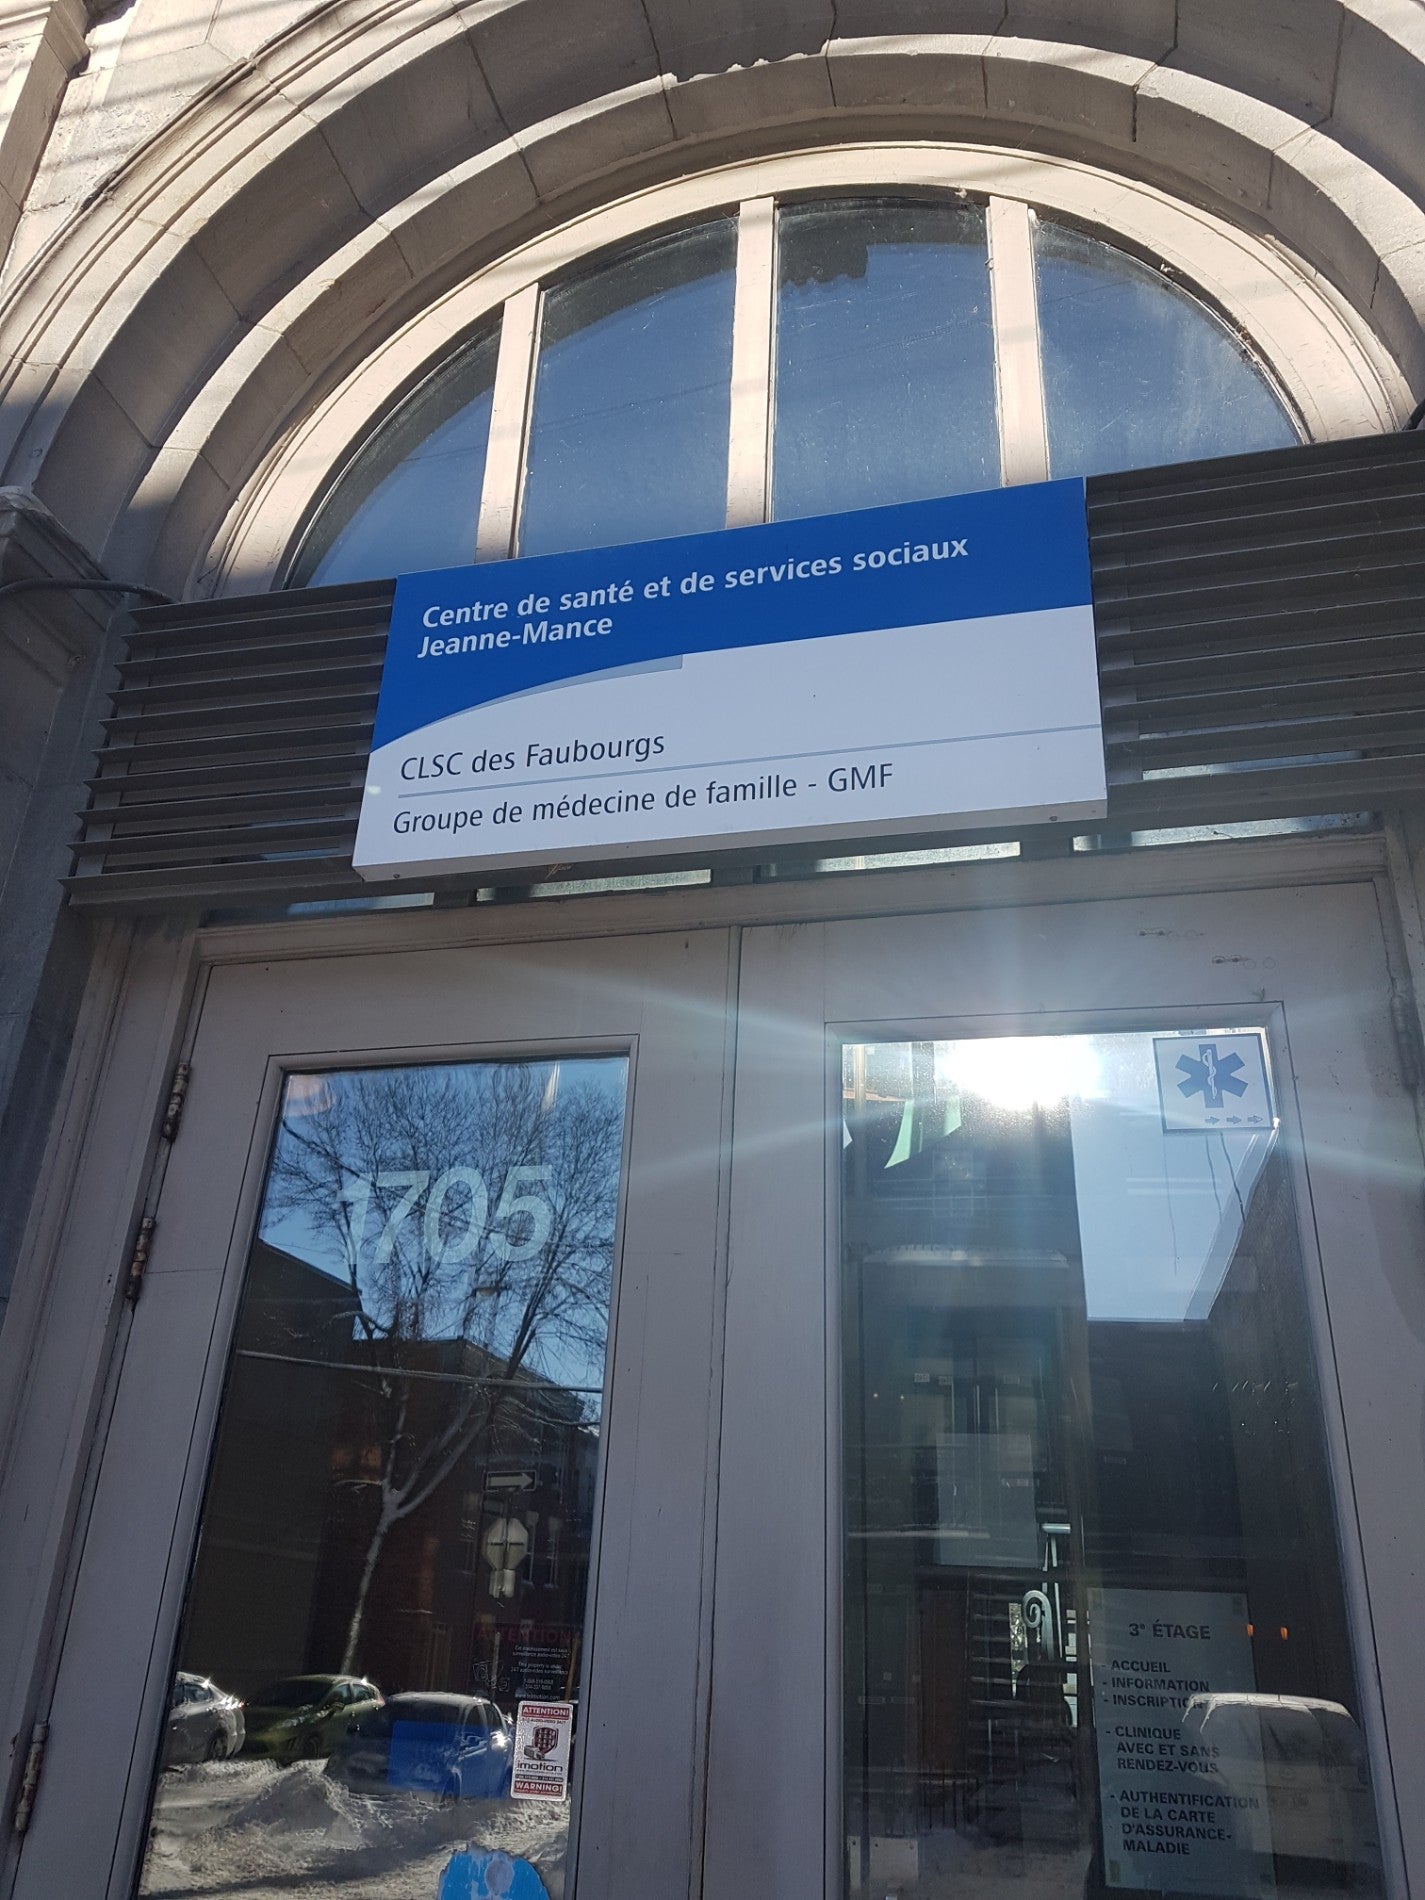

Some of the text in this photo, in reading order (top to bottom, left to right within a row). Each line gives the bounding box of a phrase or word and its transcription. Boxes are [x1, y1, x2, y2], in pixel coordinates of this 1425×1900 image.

[422, 538, 969, 628] Centre de santé et de services sociaux
[417, 617, 613, 659] Jeanne-Mance
[400, 735, 665, 781] CLSC des Faubourgs
[393, 809, 483, 835] Groupe
[492, 801, 523, 825] de
[532, 792, 655, 821] médecine
[665, 784, 697, 809] de
[705, 774, 797, 805] famille
[828, 763, 893, 792] GMF
[336, 1164, 552, 1264] 1705
[1152, 1619, 1211, 1640] ÉTAGE
[1110, 1659, 1171, 1673] ACCUEIL
[1112, 1677, 1210, 1692] INFORMATION
[523, 1706, 569, 1716] ATTENTION!
[1115, 1725, 1181, 1740] CLINIQUE
[1116, 1741, 1220, 1759] AVEC ET SANS
[517, 1761, 563, 1772] imotion
[1117, 1757, 1218, 1773] RENDEZ-VOUS
[515, 1782, 563, 1793] WARNING!
[1120, 1790, 1260, 1810] AUTHENTIFICATION
[1120, 1806, 1216, 1824] DE LA CARTE
[1122, 1840, 1190, 1855] MALADIE
